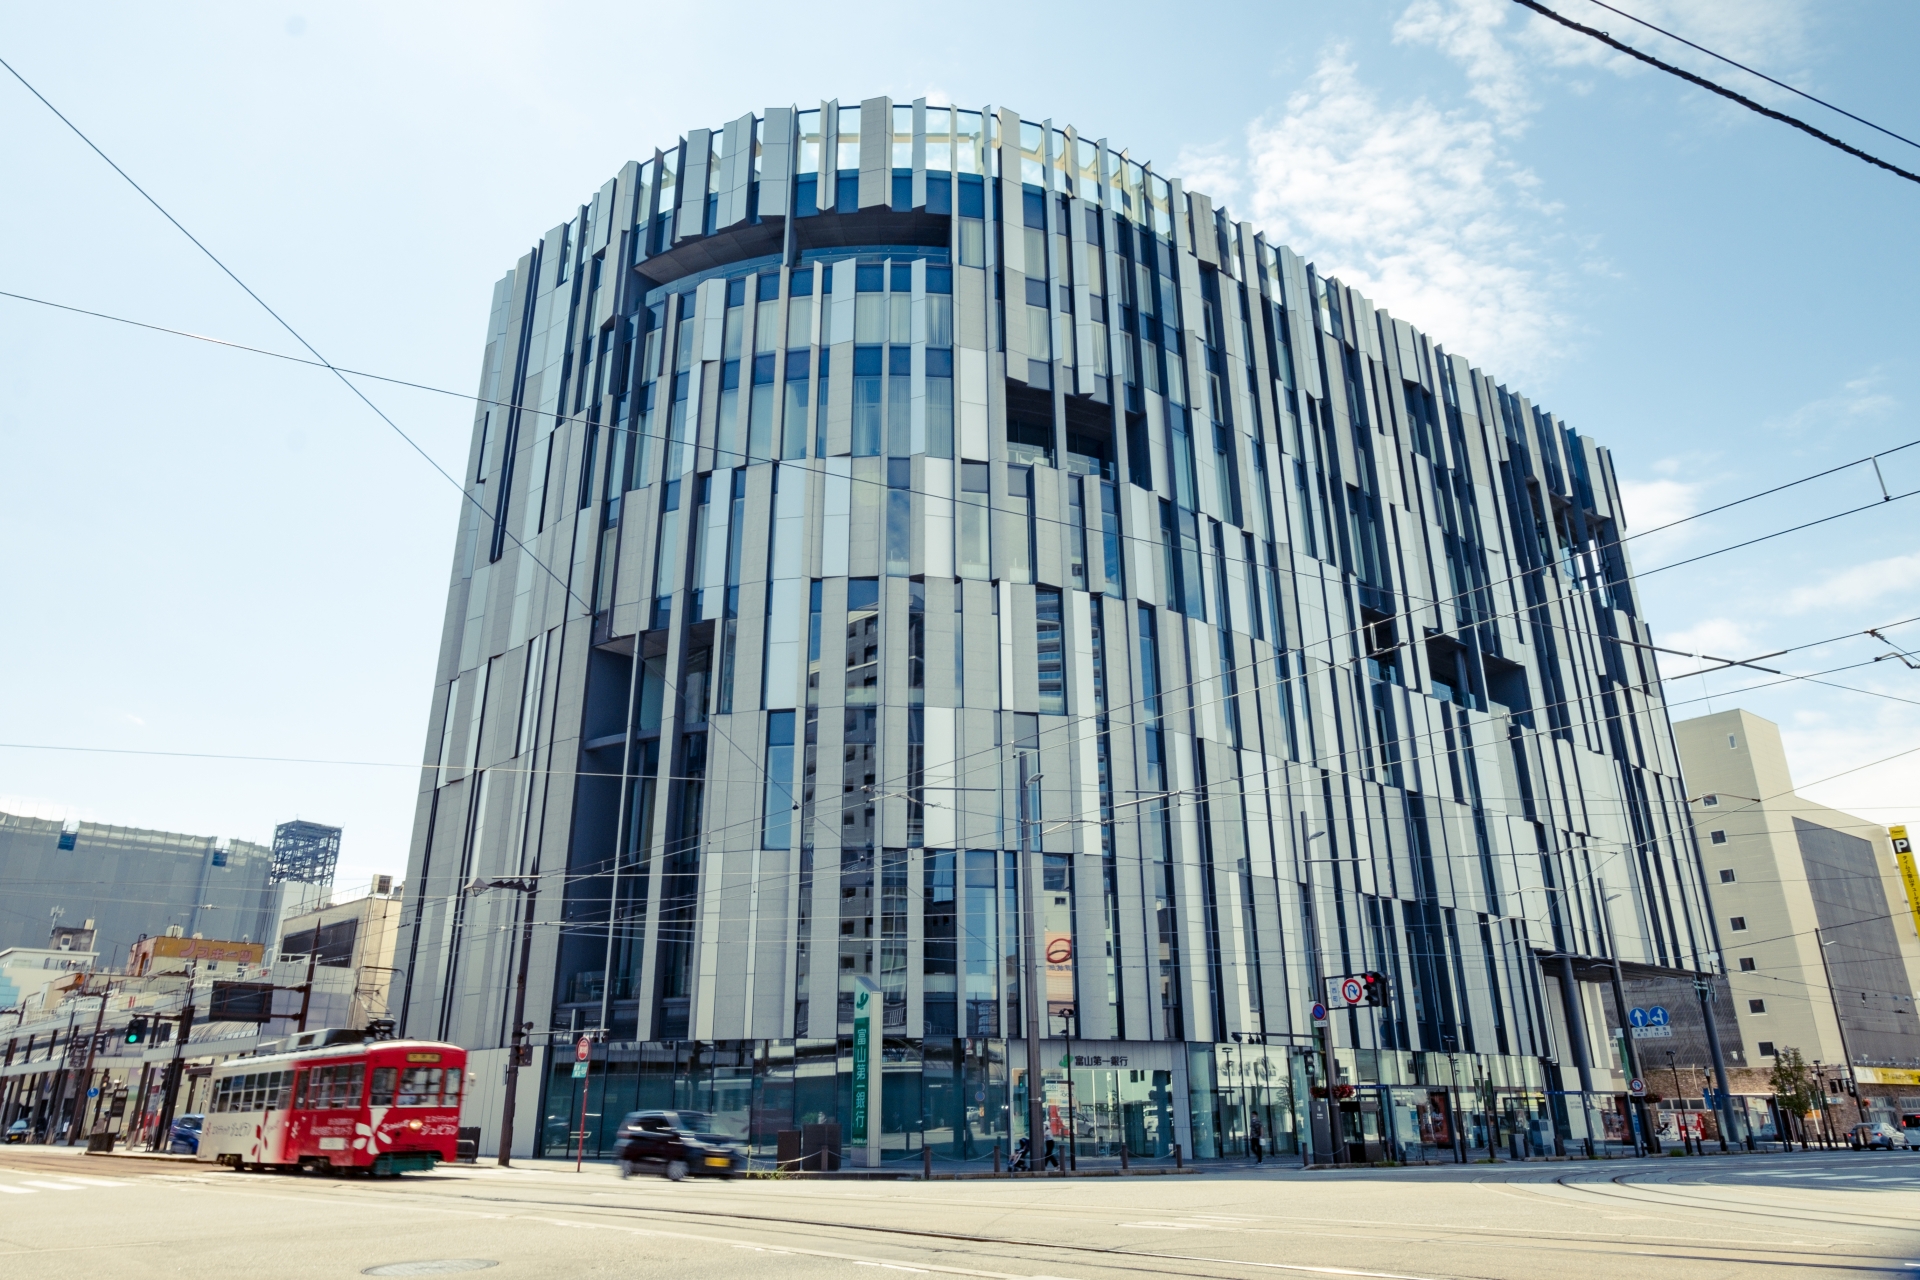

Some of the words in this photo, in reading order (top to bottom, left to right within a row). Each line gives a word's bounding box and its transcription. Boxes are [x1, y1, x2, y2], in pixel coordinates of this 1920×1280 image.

[1894, 839, 1908, 853] P
[1075, 1055, 1128, 1066] 富山第一銀行
[855, 1028, 867, 1128] 富山第一銀行
